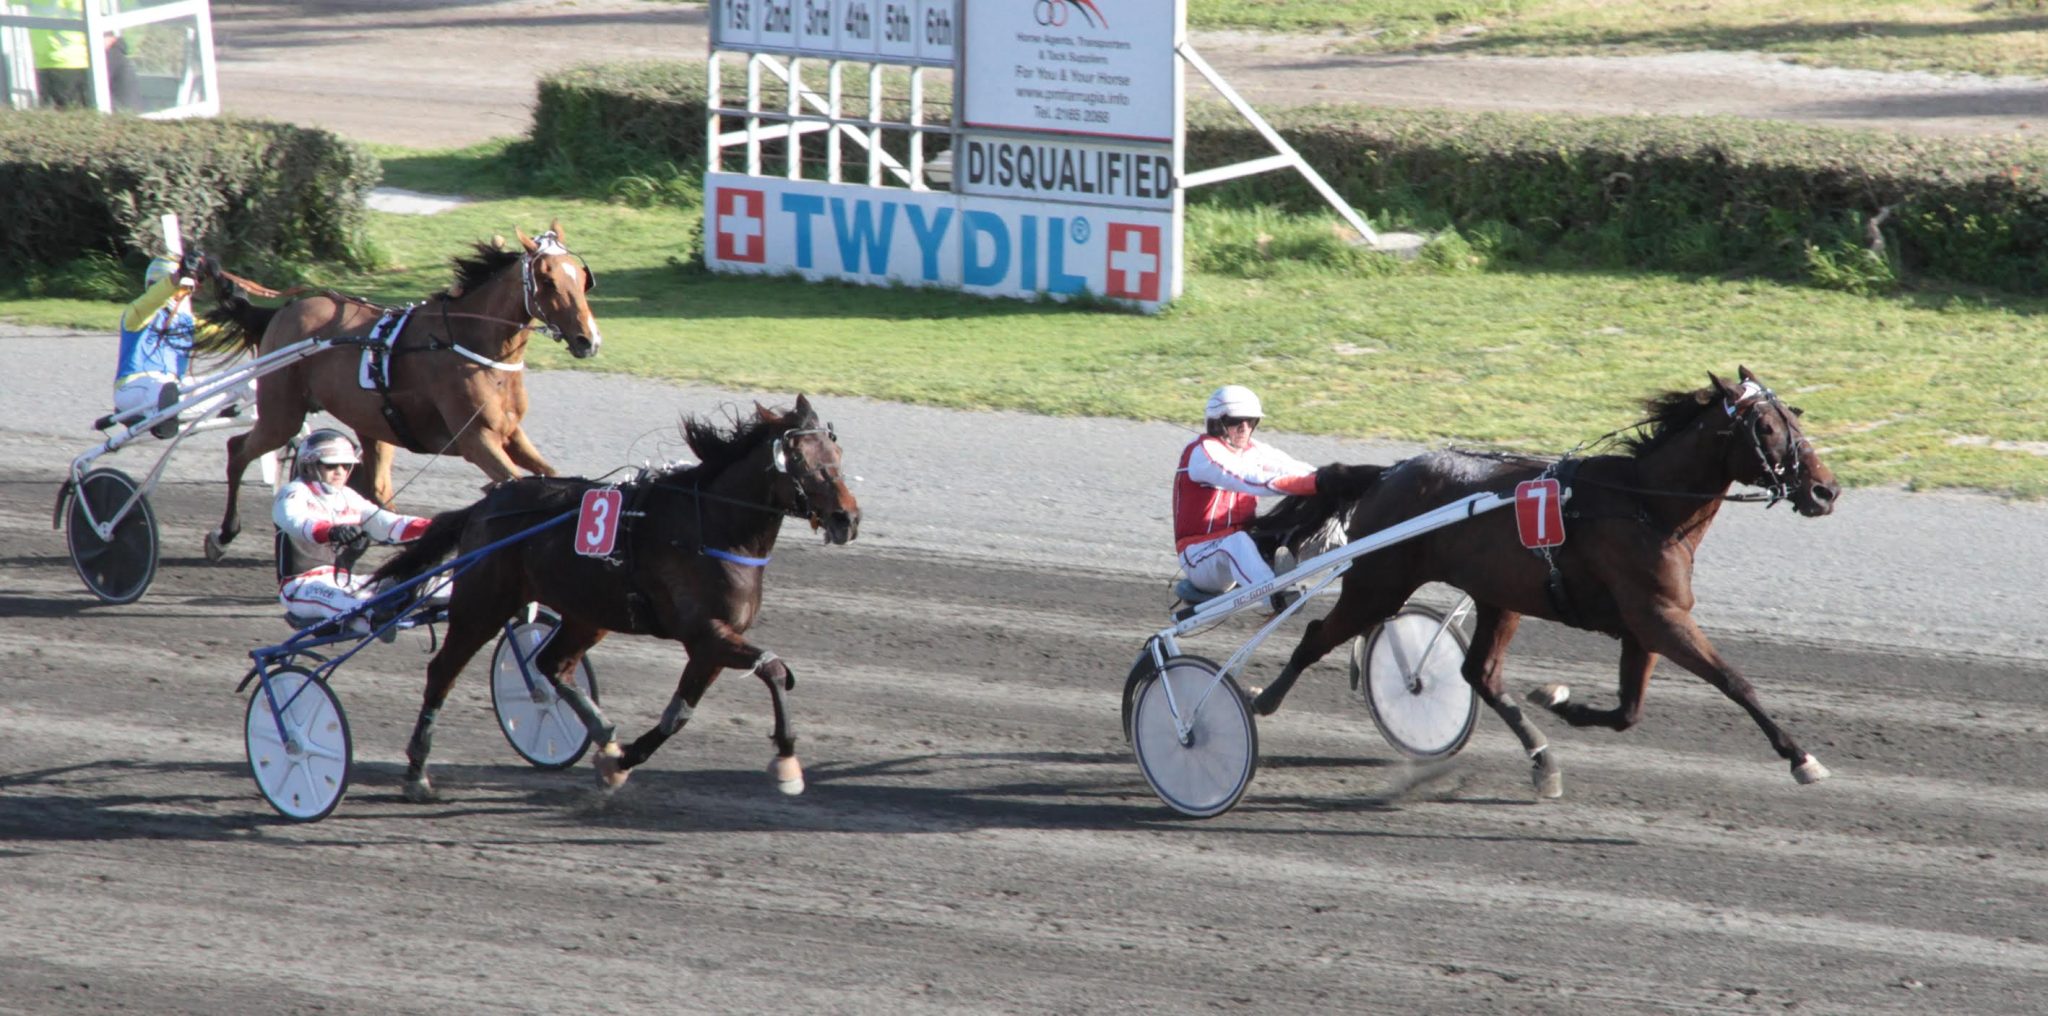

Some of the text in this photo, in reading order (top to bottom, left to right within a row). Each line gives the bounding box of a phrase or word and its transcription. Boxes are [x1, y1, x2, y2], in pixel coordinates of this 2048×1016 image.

[727, 0, 952, 45] 1st 2nd 3rd 4th 5th 6th
[1015, 65, 1033, 78] For
[1036, 67, 1056, 80] You
[1070, 69, 1095, 83] Your
[1098, 72, 1131, 86] Horse
[969, 141, 1172, 198] DISQUALIFIED
[586, 498, 609, 546] 3
[1527, 487, 1547, 539] 7
